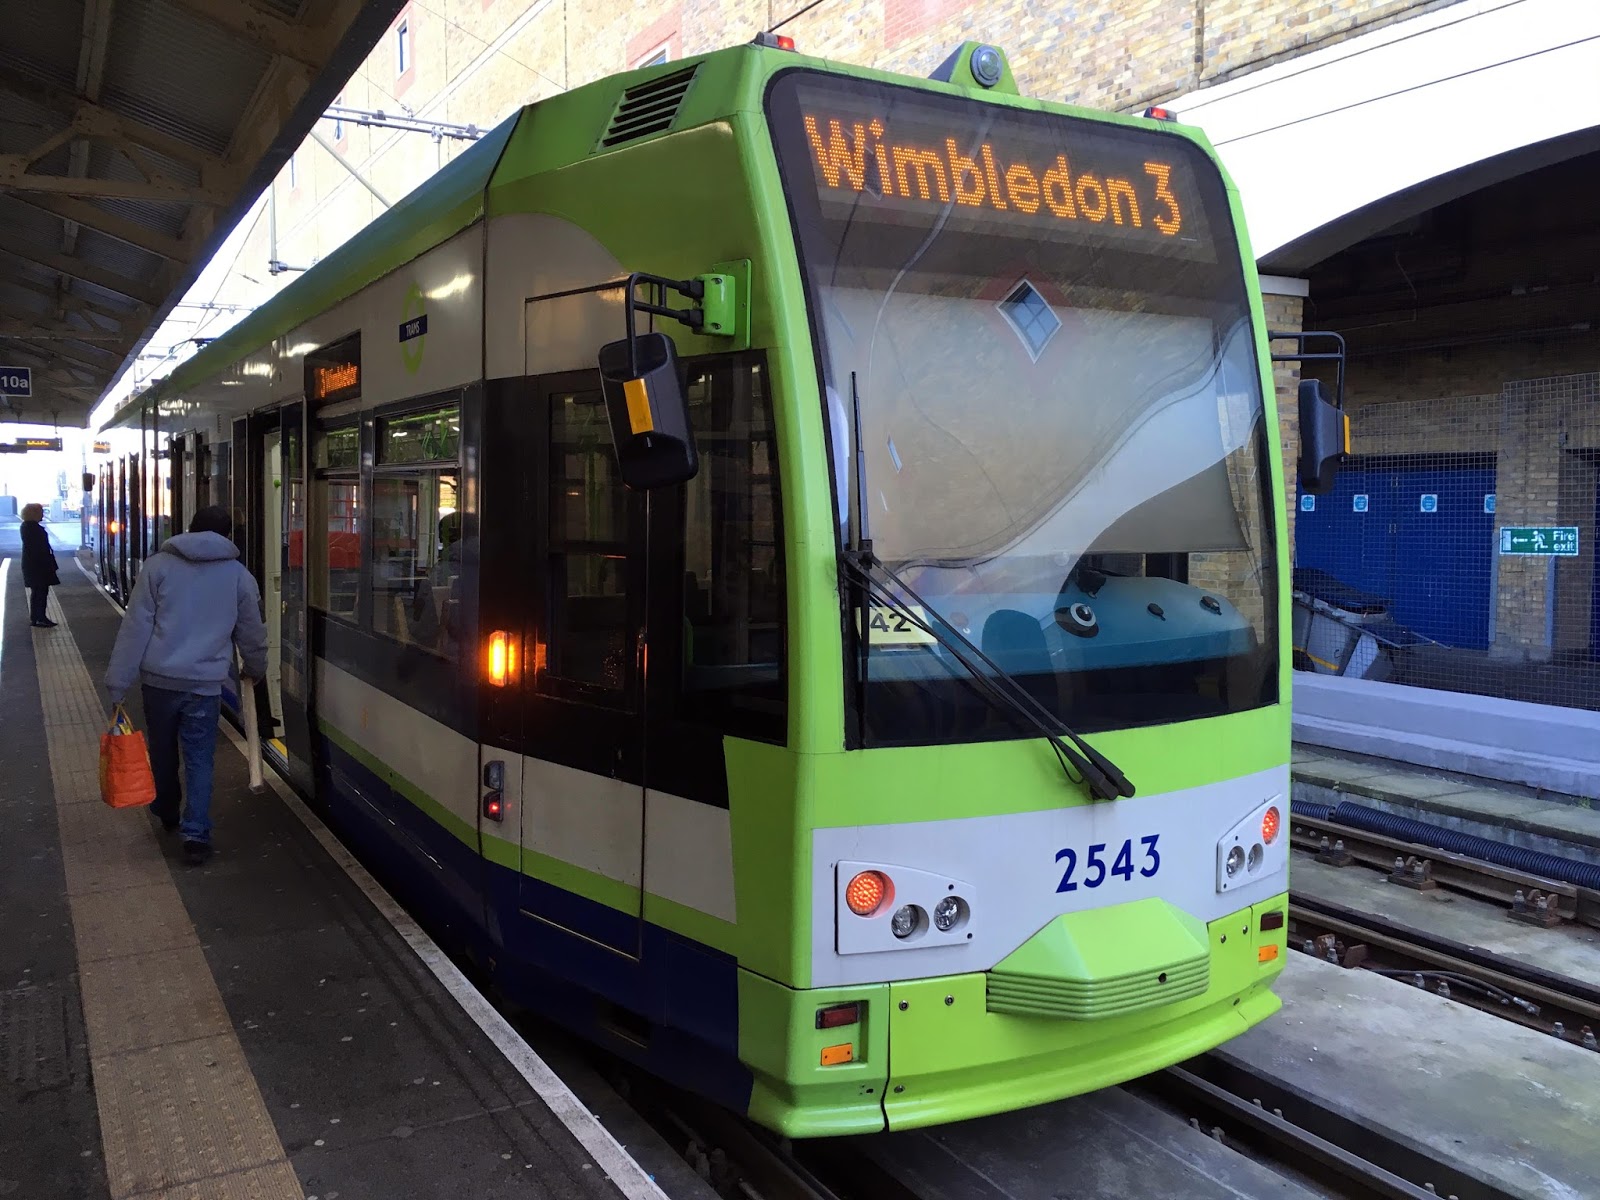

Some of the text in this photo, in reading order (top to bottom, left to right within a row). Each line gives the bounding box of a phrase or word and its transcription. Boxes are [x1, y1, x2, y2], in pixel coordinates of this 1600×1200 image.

[804, 115, 1182, 236] Wimbledon 3
[405, 320, 420, 337] TRAMS
[0, 375, 29, 389] 10a
[1553, 531, 1575, 541] Fire
[1553, 542, 1575, 552] exit
[870, 612, 912, 633] 42
[1055, 833, 1161, 894] 2543
